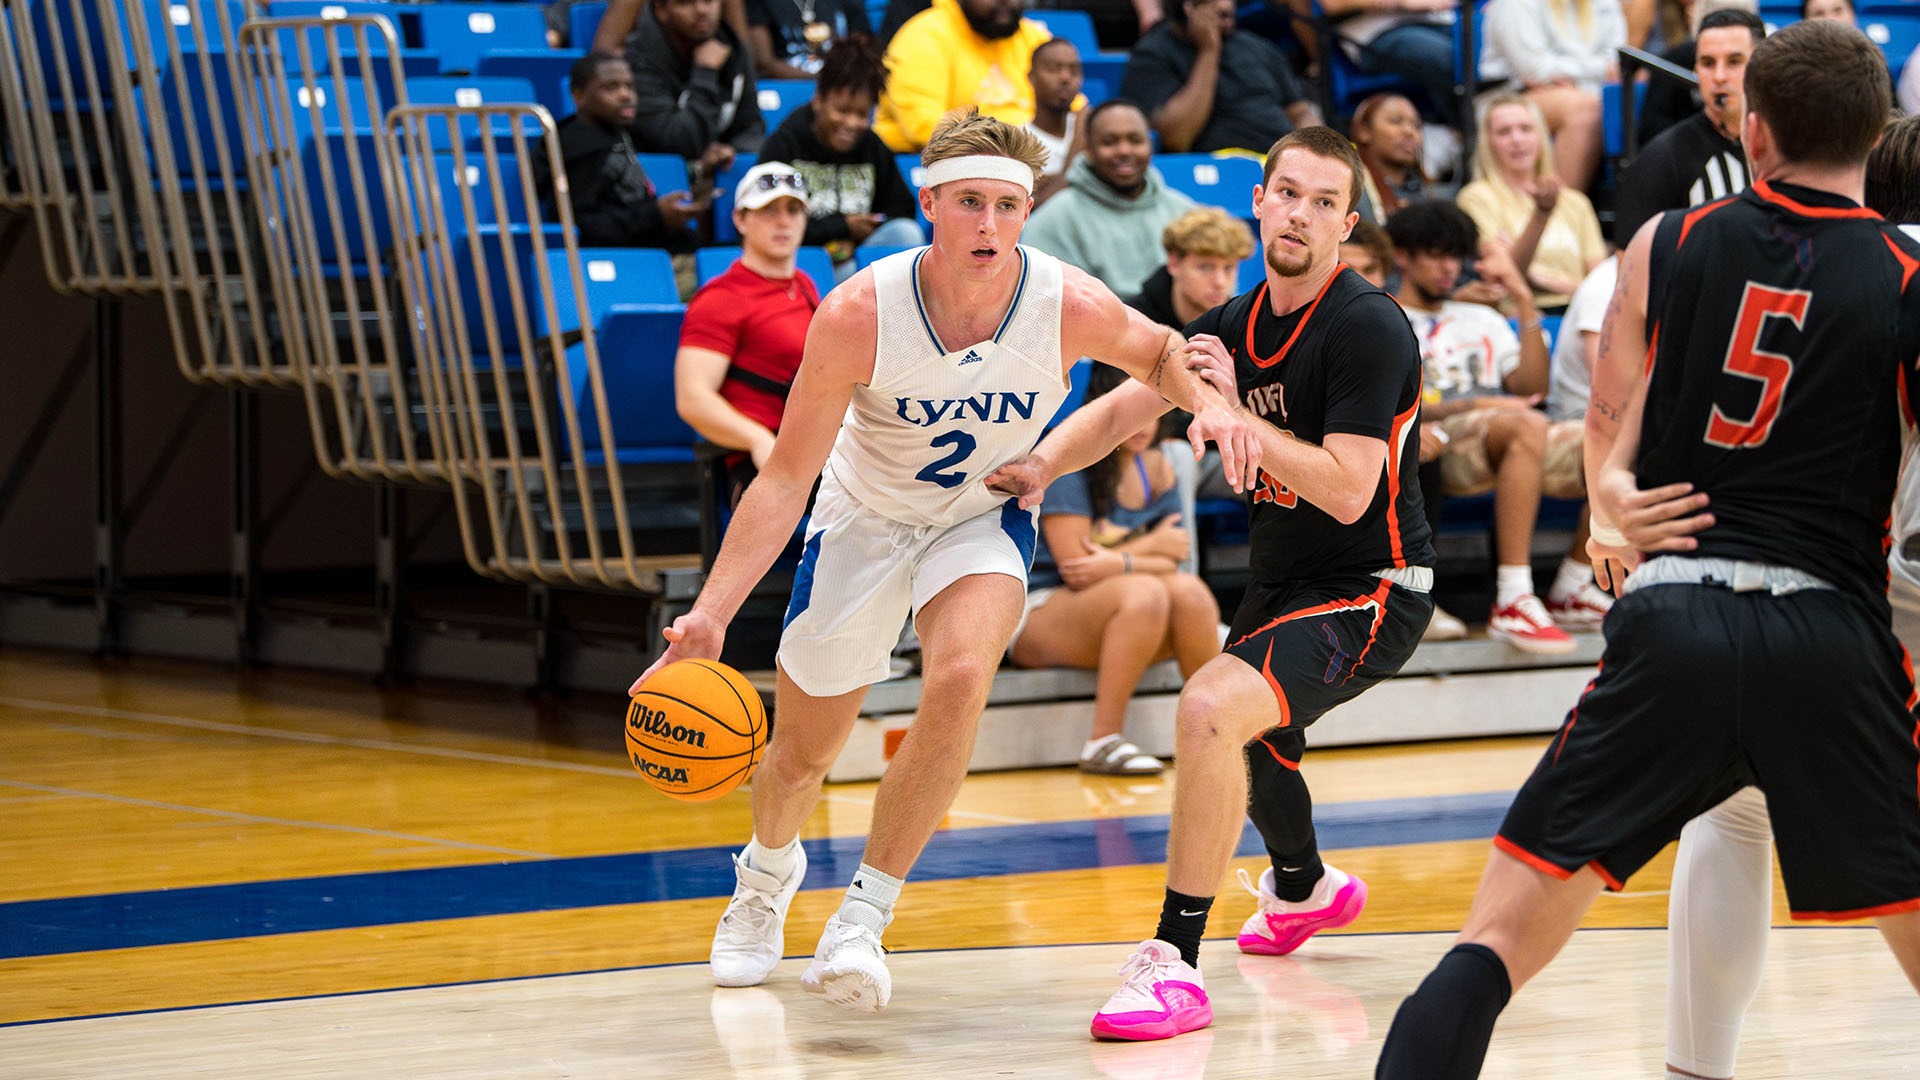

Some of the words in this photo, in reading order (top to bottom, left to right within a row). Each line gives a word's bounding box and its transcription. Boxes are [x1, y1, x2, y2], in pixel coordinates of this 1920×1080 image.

[957, 356, 983, 367] adidas
[1704, 280, 1813, 449] 5
[895, 391, 1040, 427] LYNN
[914, 429, 977, 489] 2
[629, 702, 707, 749] Wilson
[633, 752, 688, 784] NCAA
